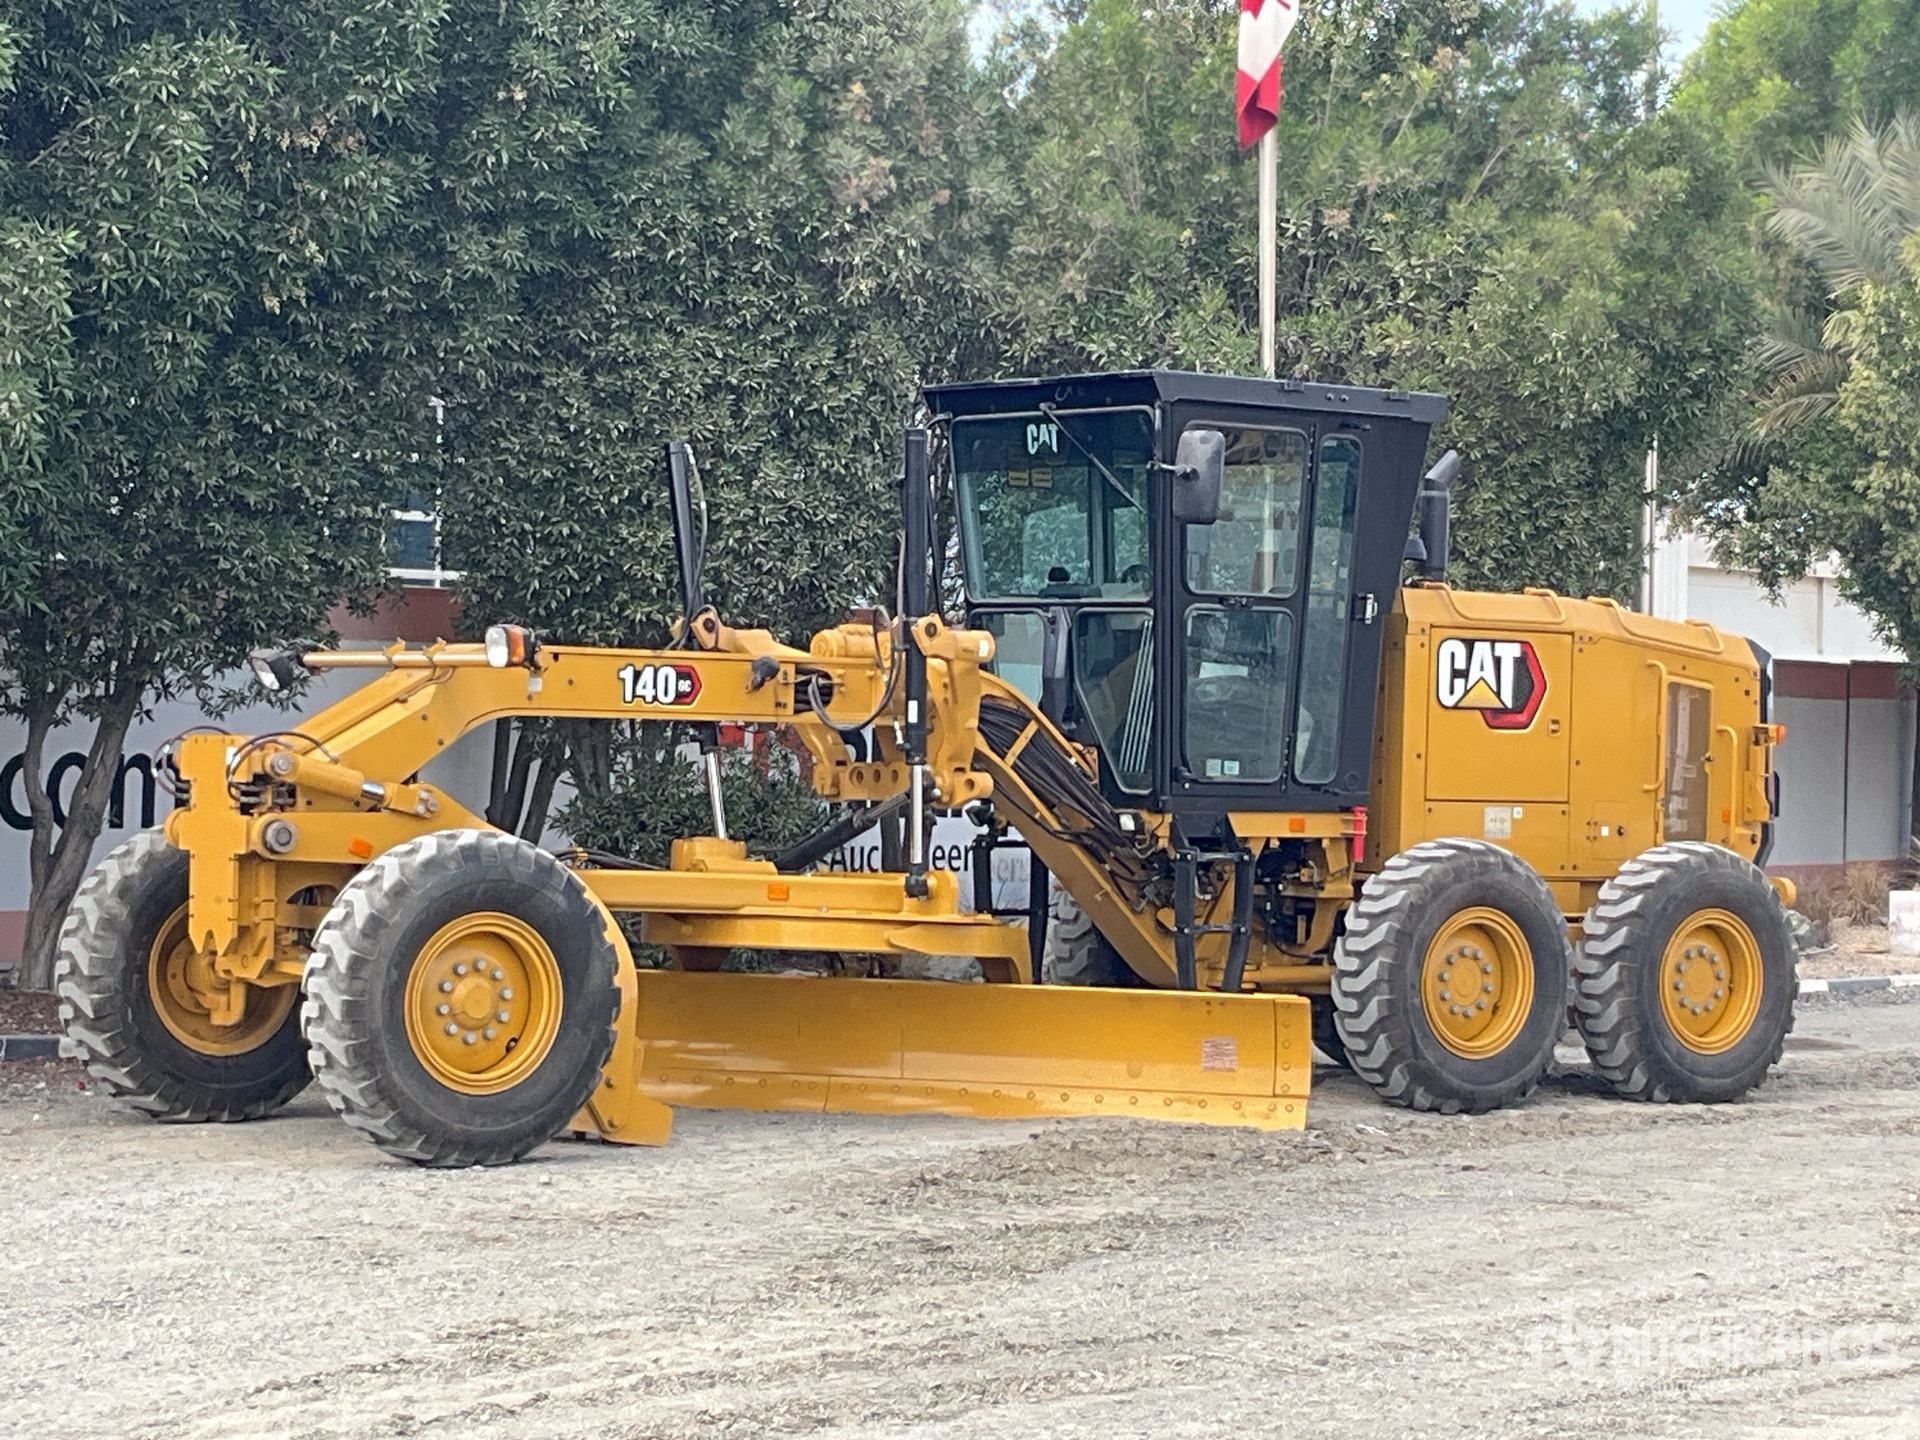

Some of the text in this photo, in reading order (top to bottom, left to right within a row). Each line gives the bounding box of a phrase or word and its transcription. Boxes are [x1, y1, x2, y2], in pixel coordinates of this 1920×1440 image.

[1025, 423, 1059, 455] CAT
[619, 665, 677, 704] 140
[1438, 639, 1521, 709] CAT
